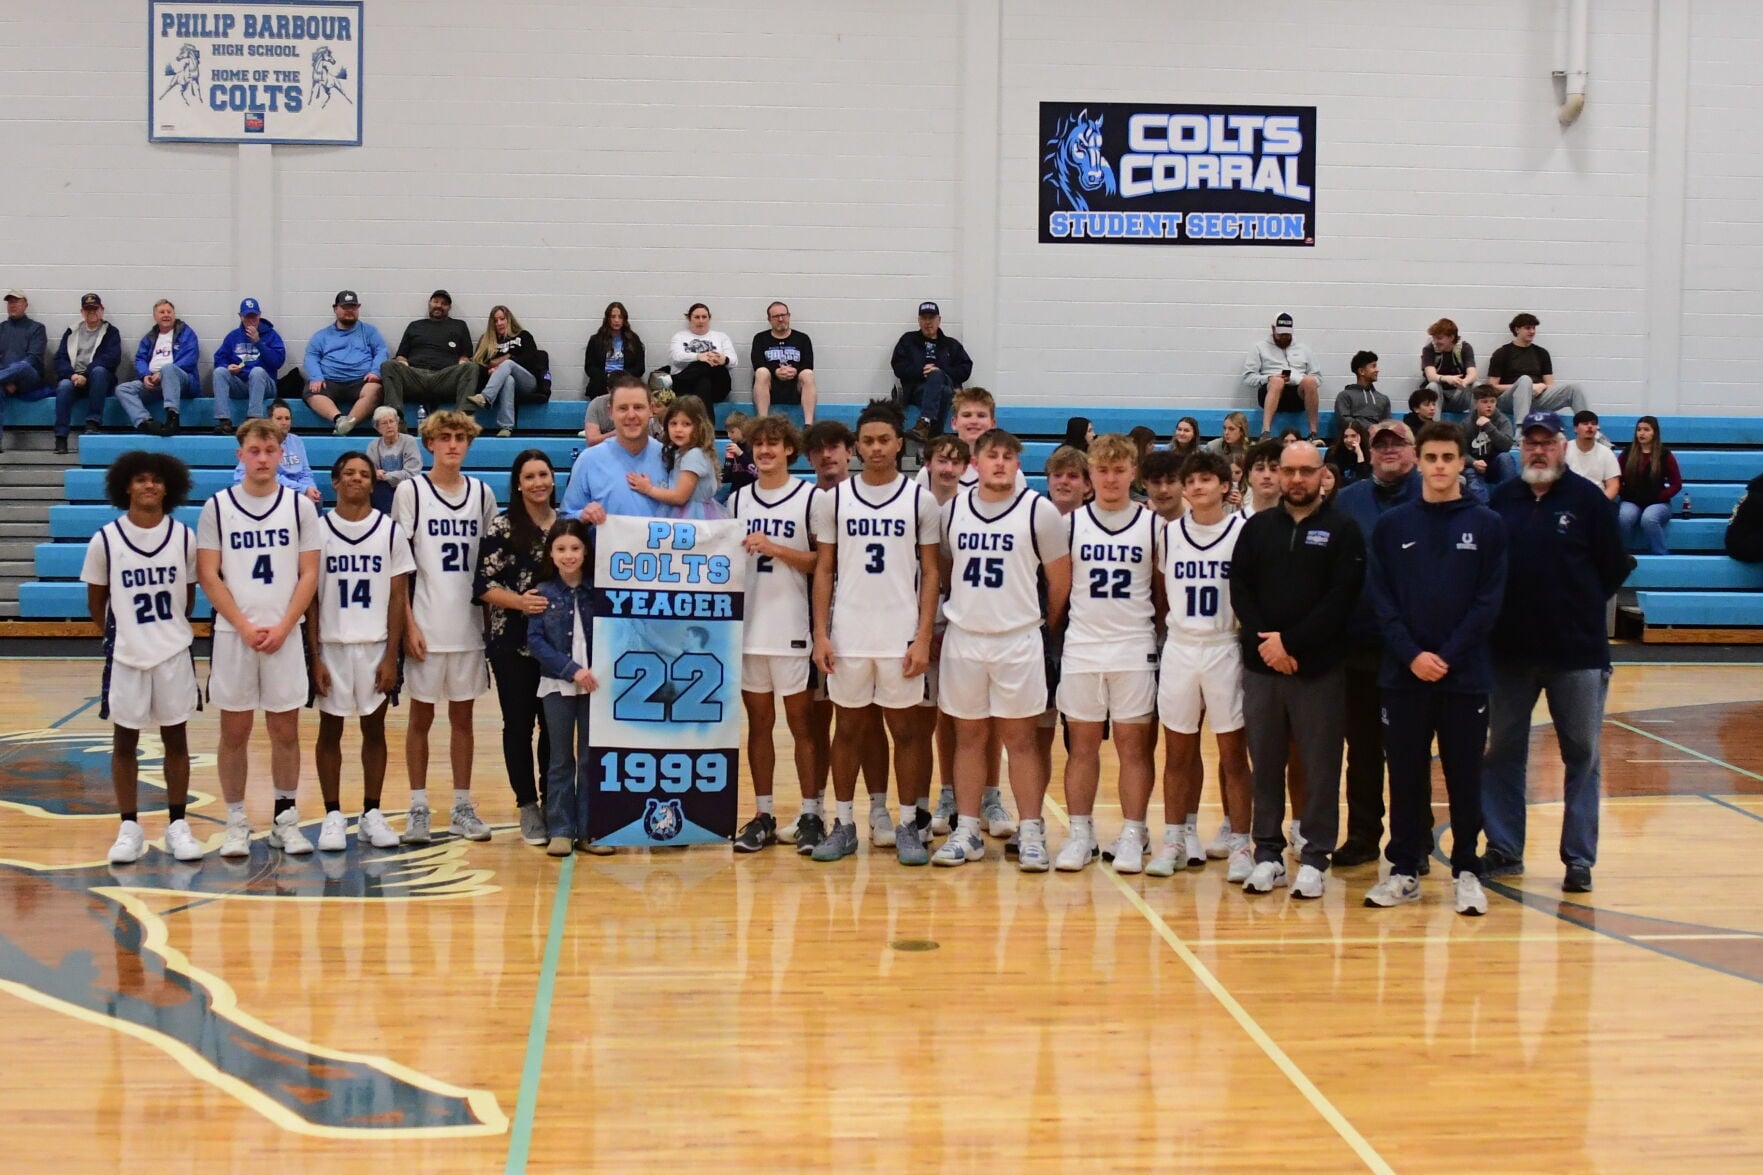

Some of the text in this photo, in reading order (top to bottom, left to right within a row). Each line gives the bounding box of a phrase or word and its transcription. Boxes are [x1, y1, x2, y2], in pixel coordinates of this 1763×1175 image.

[161, 13, 352, 41] PHILIP BARBOUR
[212, 44, 300, 58] HIGH SCHOOL
[211, 69, 300, 83] HOME OF THE
[209, 84, 303, 113] COLTS
[1128, 113, 1302, 155] COLTS
[1120, 153, 1311, 202] CORRAL
[1049, 211, 1305, 240] STUDENT SECTION
[230, 528, 290, 550] COLTS
[428, 519, 478, 537] COLTS
[646, 521, 696, 550] PB
[846, 518, 906, 537] COLTS
[957, 532, 1014, 552] COLTS
[326, 555, 382, 574] COLTS
[441, 542, 470, 572] 21
[609, 551, 731, 584] COLTS
[865, 543, 885, 574] 3
[1080, 544, 1143, 563] COLTS
[121, 566, 177, 588] COLTS
[252, 554, 274, 585] 4
[963, 557, 1004, 588] 45
[1089, 568, 1132, 599] 22
[1174, 560, 1231, 580] COLTS
[133, 590, 173, 624] 20
[338, 579, 372, 609] 14
[605, 590, 733, 617] YEAGER
[1185, 585, 1219, 617] 10
[613, 650, 724, 722] 22
[600, 751, 728, 793] 1999
